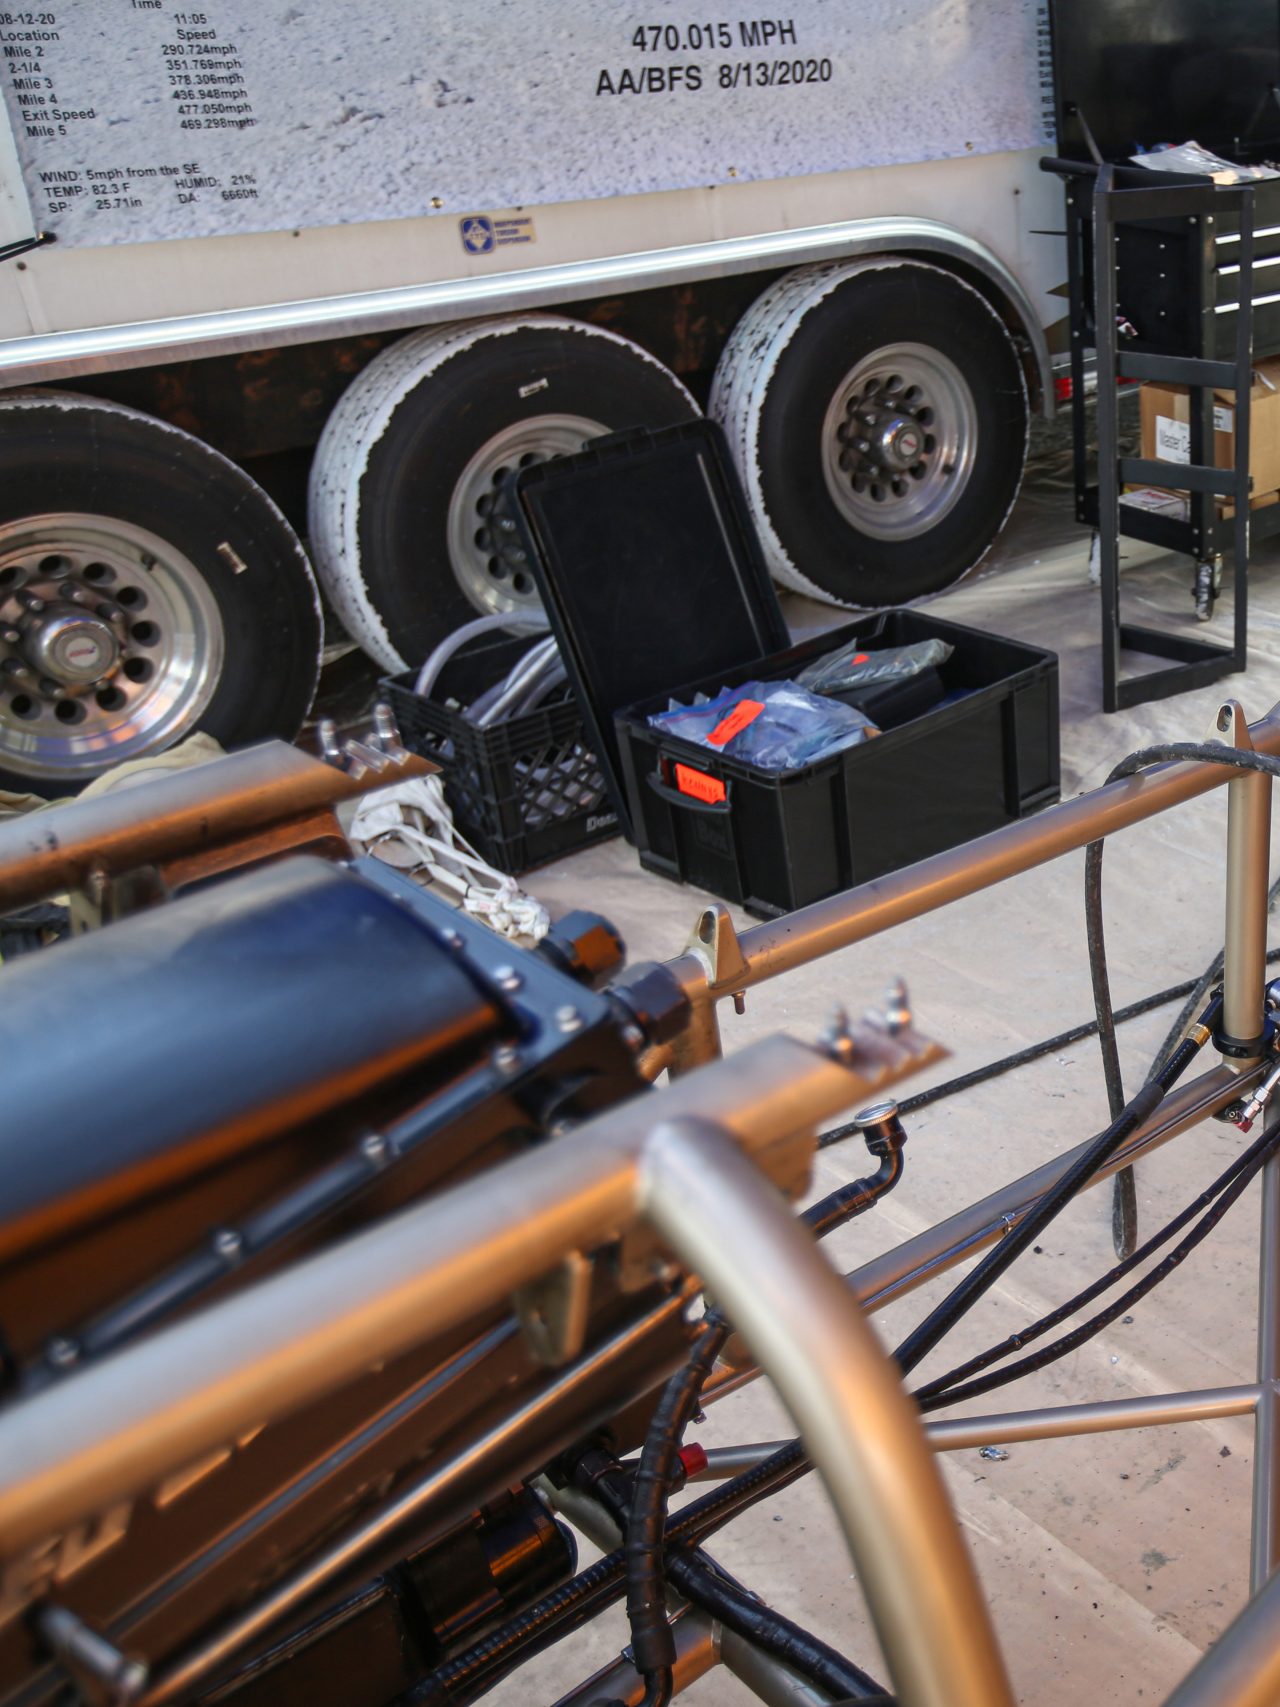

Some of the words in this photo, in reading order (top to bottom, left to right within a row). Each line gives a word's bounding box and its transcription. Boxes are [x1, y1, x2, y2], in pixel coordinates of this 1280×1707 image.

[174, 13, 207, 25] 11:05
[0, 29, 60, 41] Location
[176, 29, 216, 41] Speed
[632, 22, 733, 52] 470.015
[738, 18, 798, 48] MPH
[4, 46, 32, 57] Mile
[35, 46, 44, 57] 2
[161, 43, 238, 56] 290.724mph
[8, 62, 42, 74] 2-1/4
[595, 64, 703, 97] AA/BFS
[717, 57, 833, 90] 8/13/2020
[13, 78, 41, 90] Mile
[44, 78, 53, 89] 3
[17, 94, 46, 106] Mile
[49, 94, 58, 104] 4
[22, 110, 50, 122] Exit
[52, 108, 96, 122] Speed
[26, 126, 55, 137] Mile
[58, 125, 67, 136] 5
[39, 169, 82, 183] WIND:
[86, 168, 124, 182] 5mph
[126, 166, 156, 178] from
[160, 165, 180, 176] the
[183, 163, 201, 175] SE
[231, 174, 257, 186] 21%
[44, 185, 89, 199] TEMP:
[92, 183, 119, 195] 82.3
[123, 182, 131, 193] F
[178, 193, 201, 205] DA:
[48, 202, 72, 214] SP:
[96, 197, 143, 211] 25.71in
